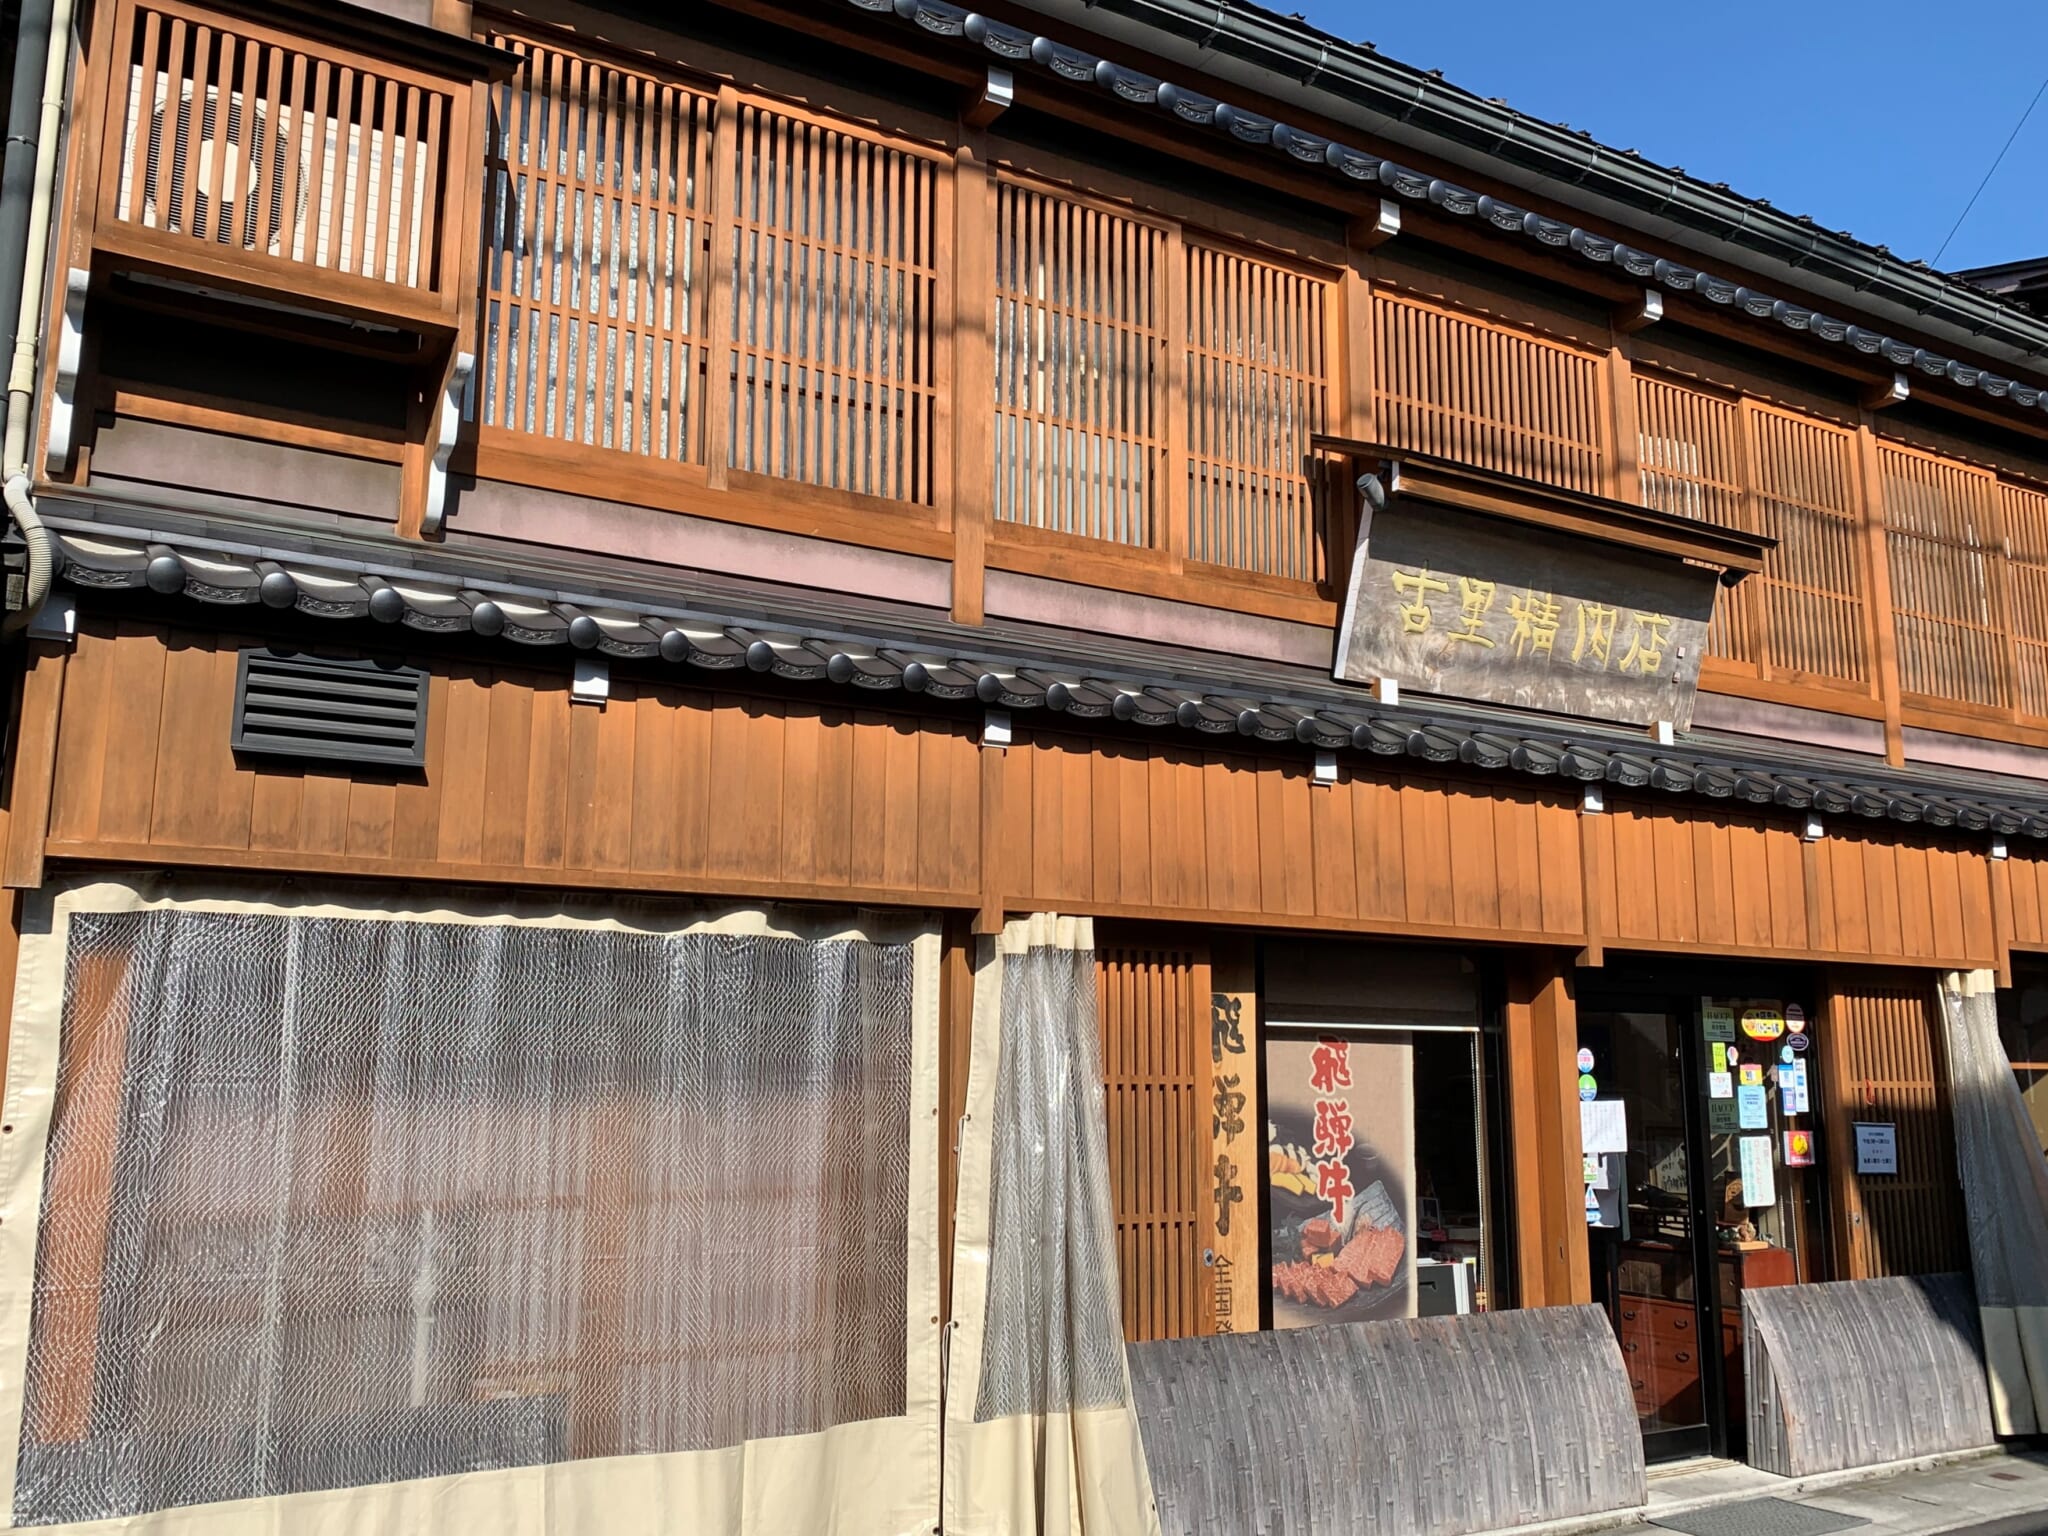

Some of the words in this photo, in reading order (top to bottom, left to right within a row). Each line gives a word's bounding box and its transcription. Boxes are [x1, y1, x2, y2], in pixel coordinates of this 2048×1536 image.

[1391, 560, 1672, 673] 古里精肉店
[1310, 1035, 1355, 1223] 飛騨牛
